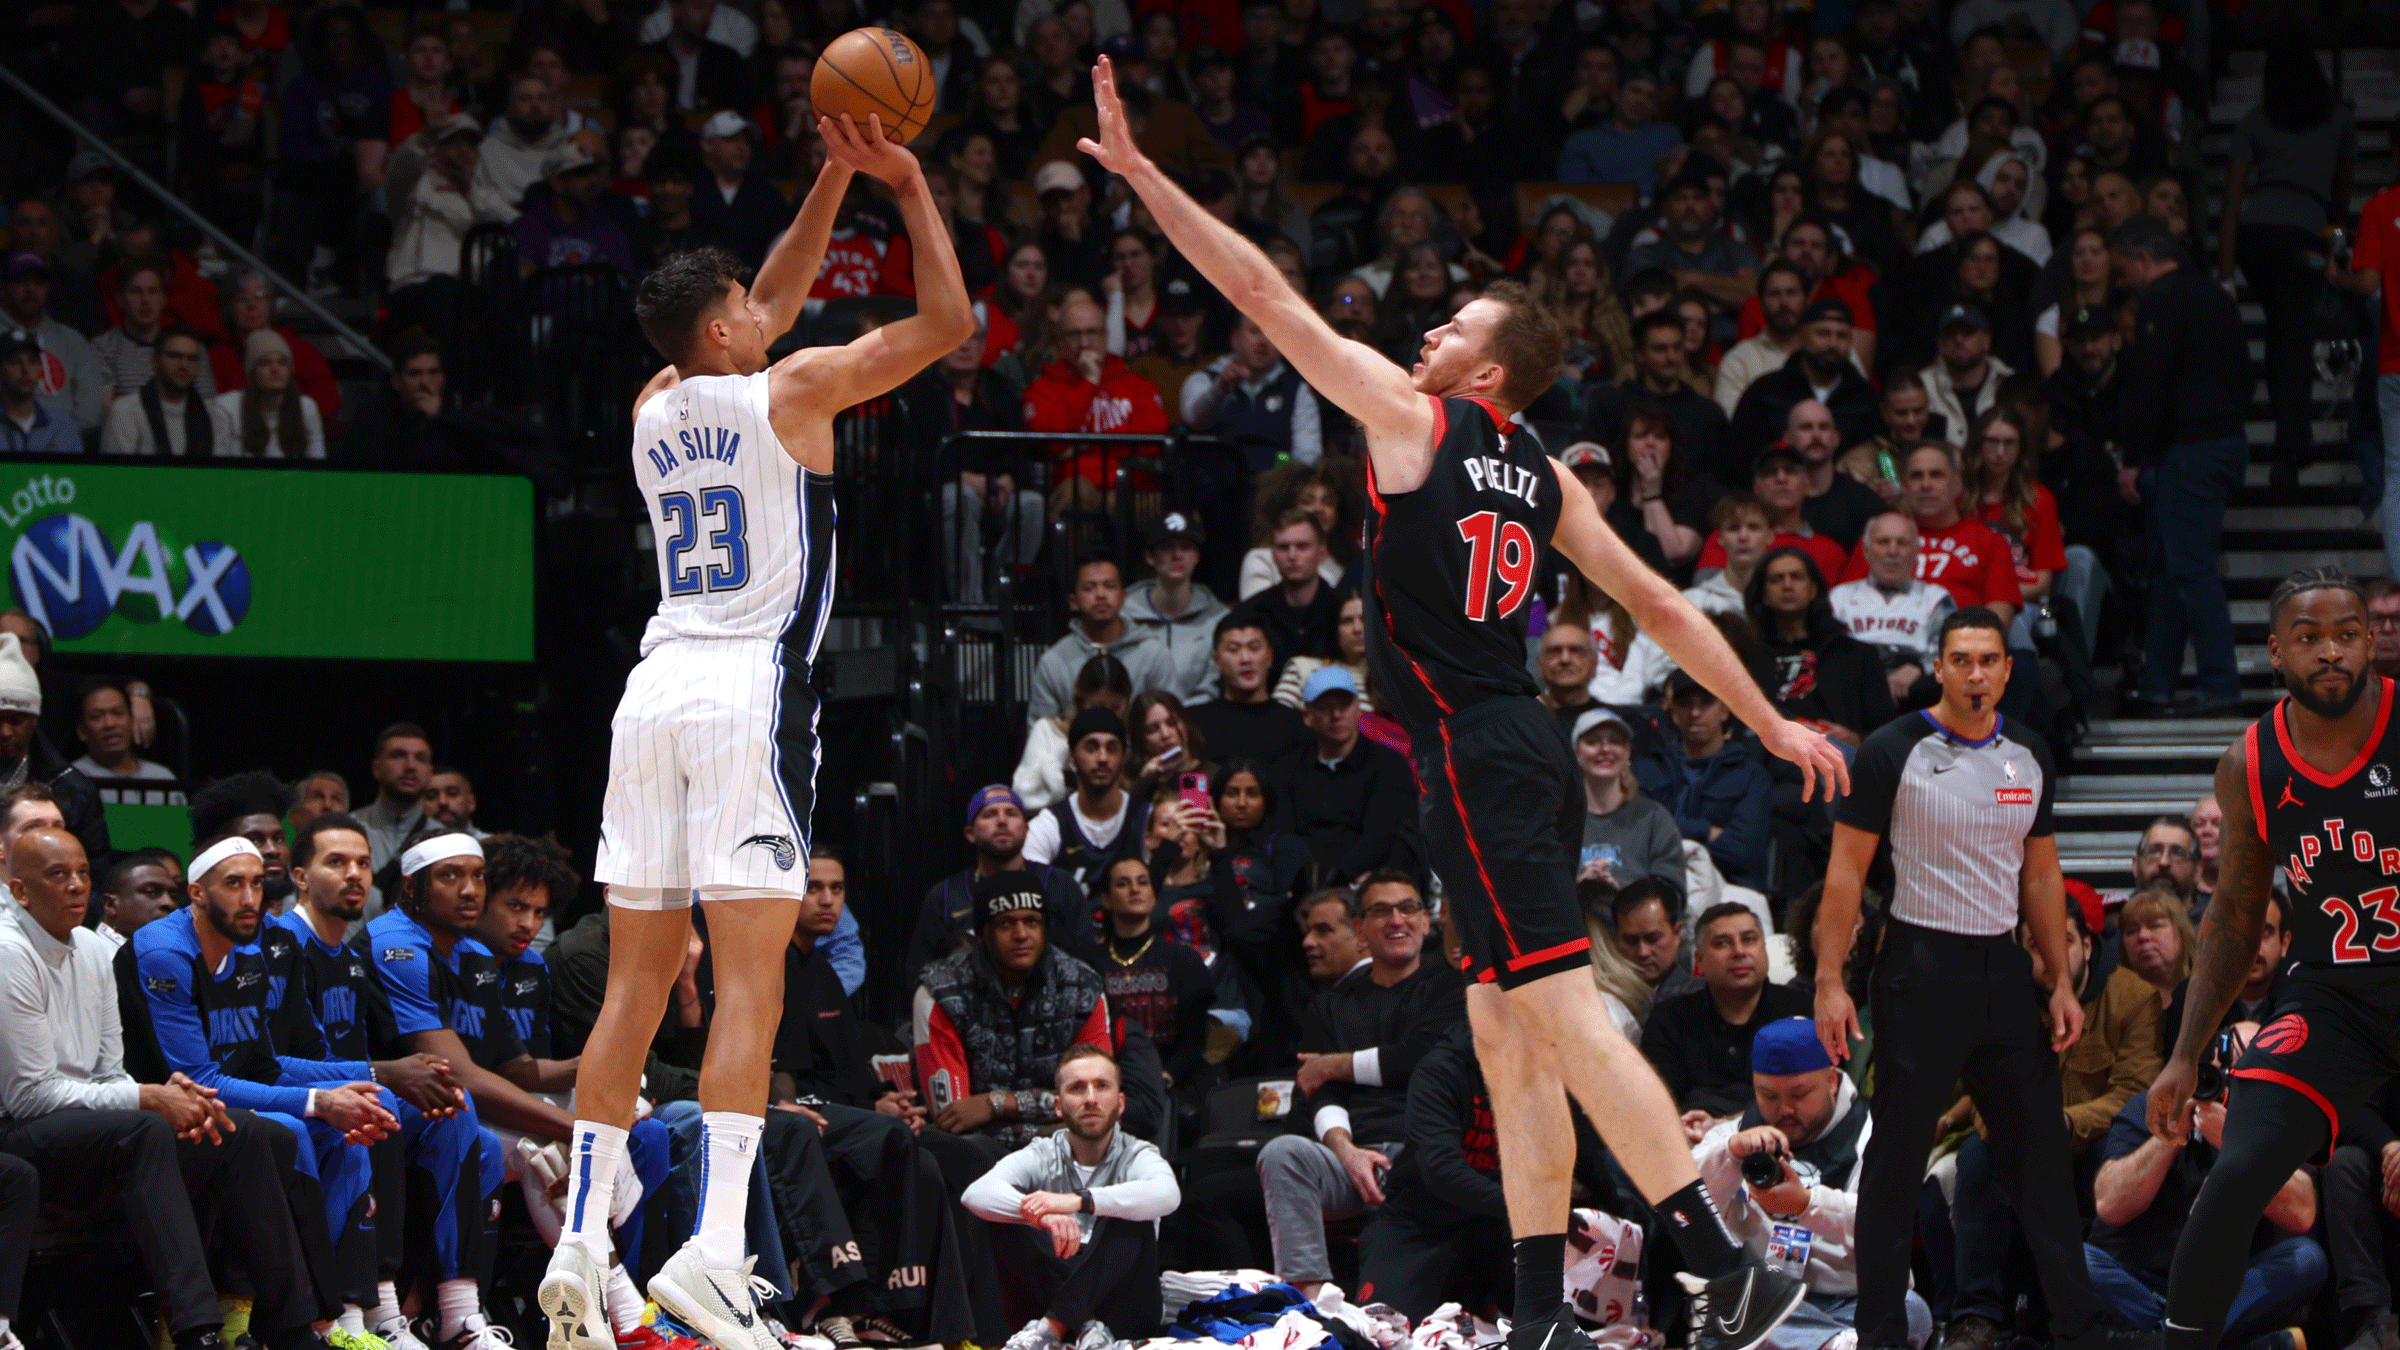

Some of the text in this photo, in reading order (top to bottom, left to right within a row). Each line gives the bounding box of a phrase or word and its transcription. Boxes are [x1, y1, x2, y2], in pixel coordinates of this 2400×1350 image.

[647, 426, 741, 479] DA SILVA
[0, 474, 77, 529] Lotto
[658, 485, 751, 597] 23
[1456, 510, 1536, 622] 19
[1915, 553, 1951, 579] 17
[11, 513, 238, 636] MAX
[1996, 790, 2033, 802] Emirates
[2364, 786, 2399, 799] Sun Life
[2319, 885, 2400, 964] 23
[831, 1240, 862, 1270] AS
[888, 1265, 927, 1291] RUI
